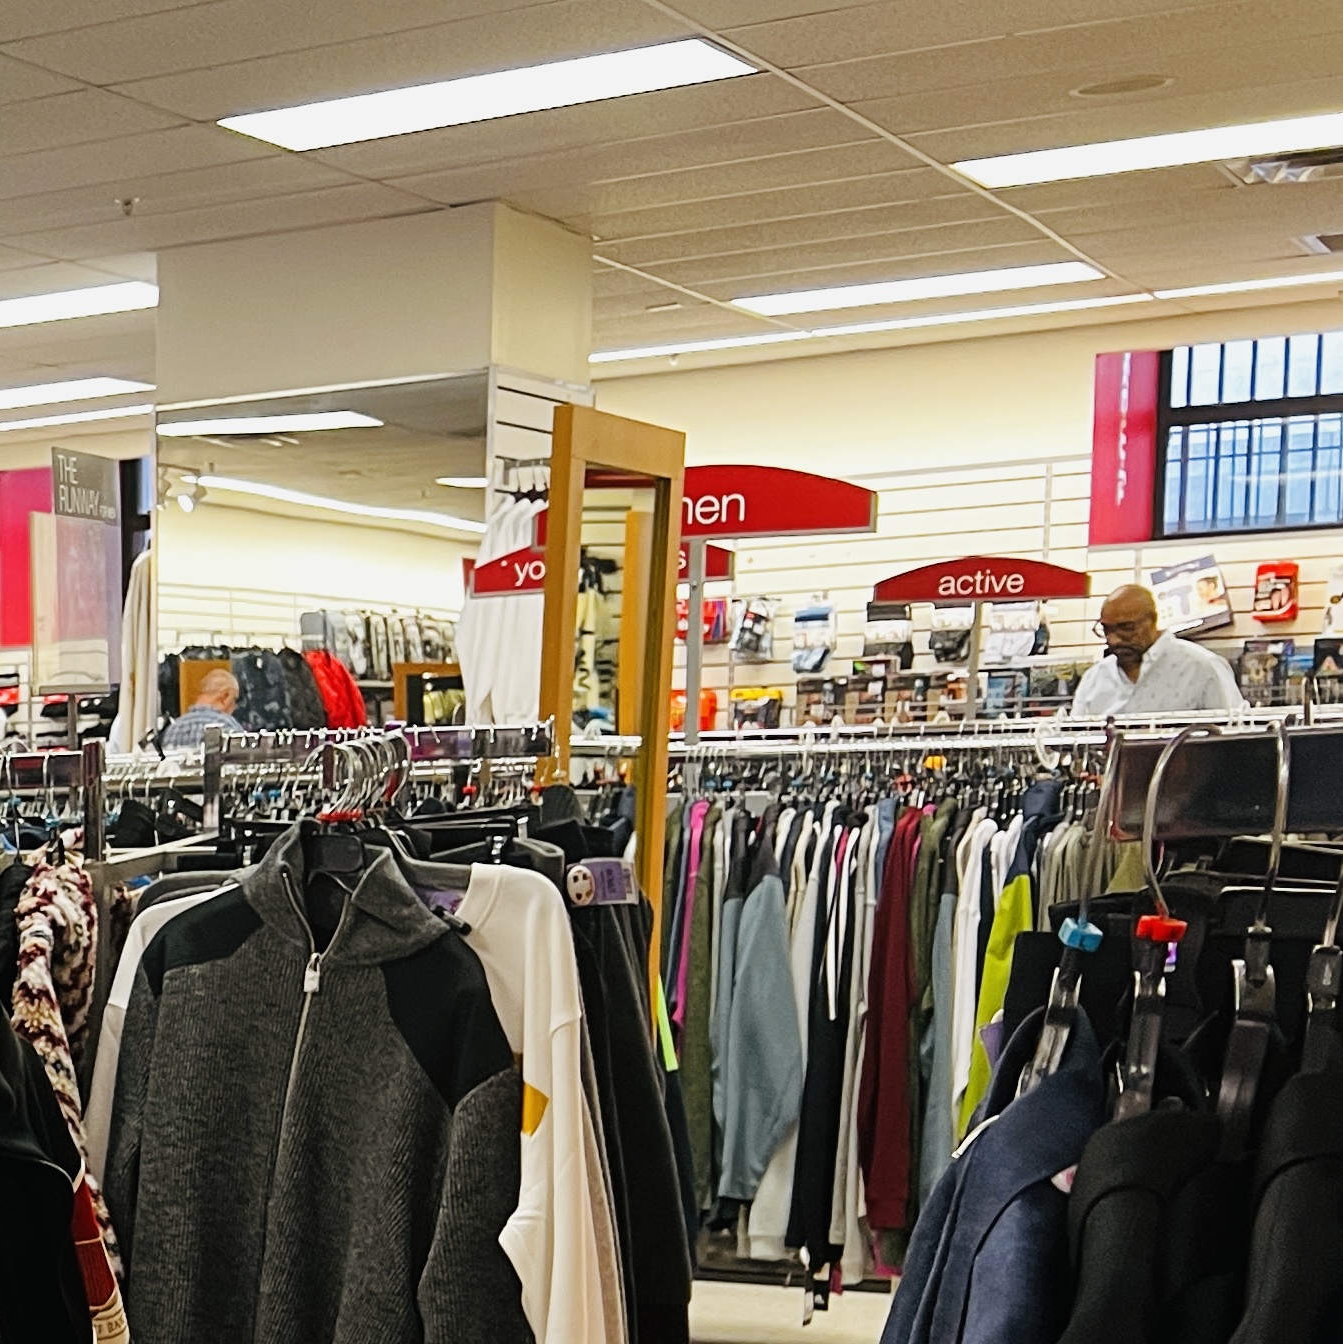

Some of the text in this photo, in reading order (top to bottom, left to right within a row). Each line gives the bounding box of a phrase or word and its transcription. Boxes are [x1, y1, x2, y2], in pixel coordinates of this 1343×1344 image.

[57, 454, 78, 485] THE
[681, 490, 746, 526] en
[938, 569, 1025, 596] active
